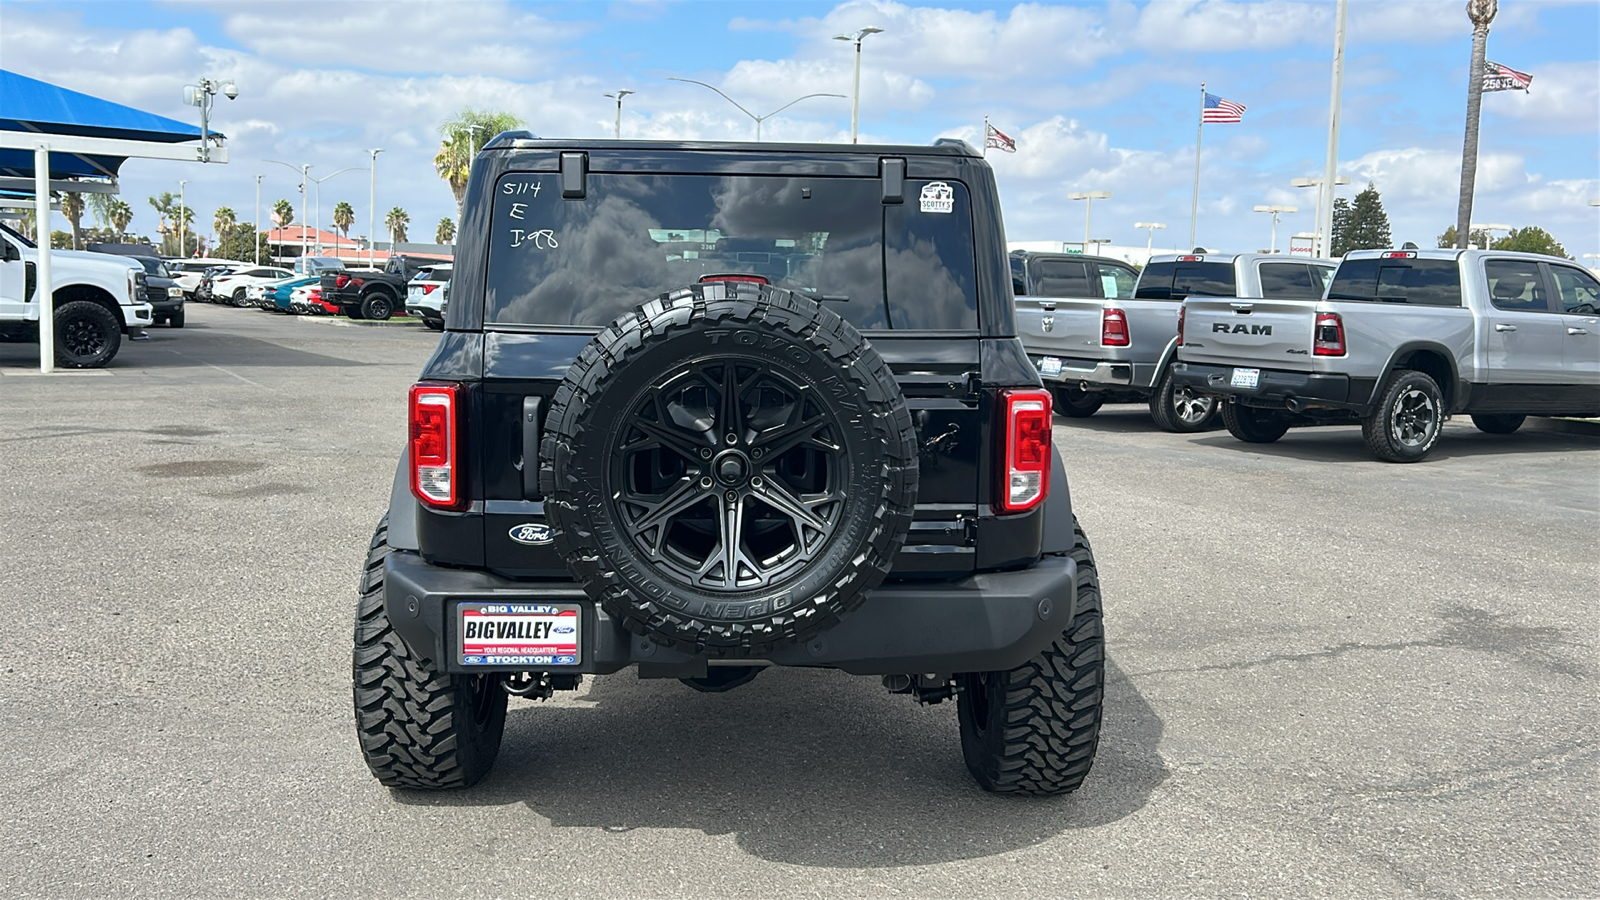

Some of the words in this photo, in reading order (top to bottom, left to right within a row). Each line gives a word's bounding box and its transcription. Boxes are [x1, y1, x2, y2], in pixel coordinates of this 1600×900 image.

[509, 202, 529, 220] E
[1212, 323, 1273, 336] RAM
[703, 329, 812, 364] TOYO
[518, 526, 550, 540] Ford
[488, 605, 509, 614] BIG
[511, 605, 552, 614] VALLEY
[700, 591, 794, 619] OPEN
[483, 646, 497, 654] YOUR
[498, 646, 520, 654] REGIONAL
[521, 646, 558, 654] HEADQUARTERS
[486, 655, 553, 664] STOCKTON
